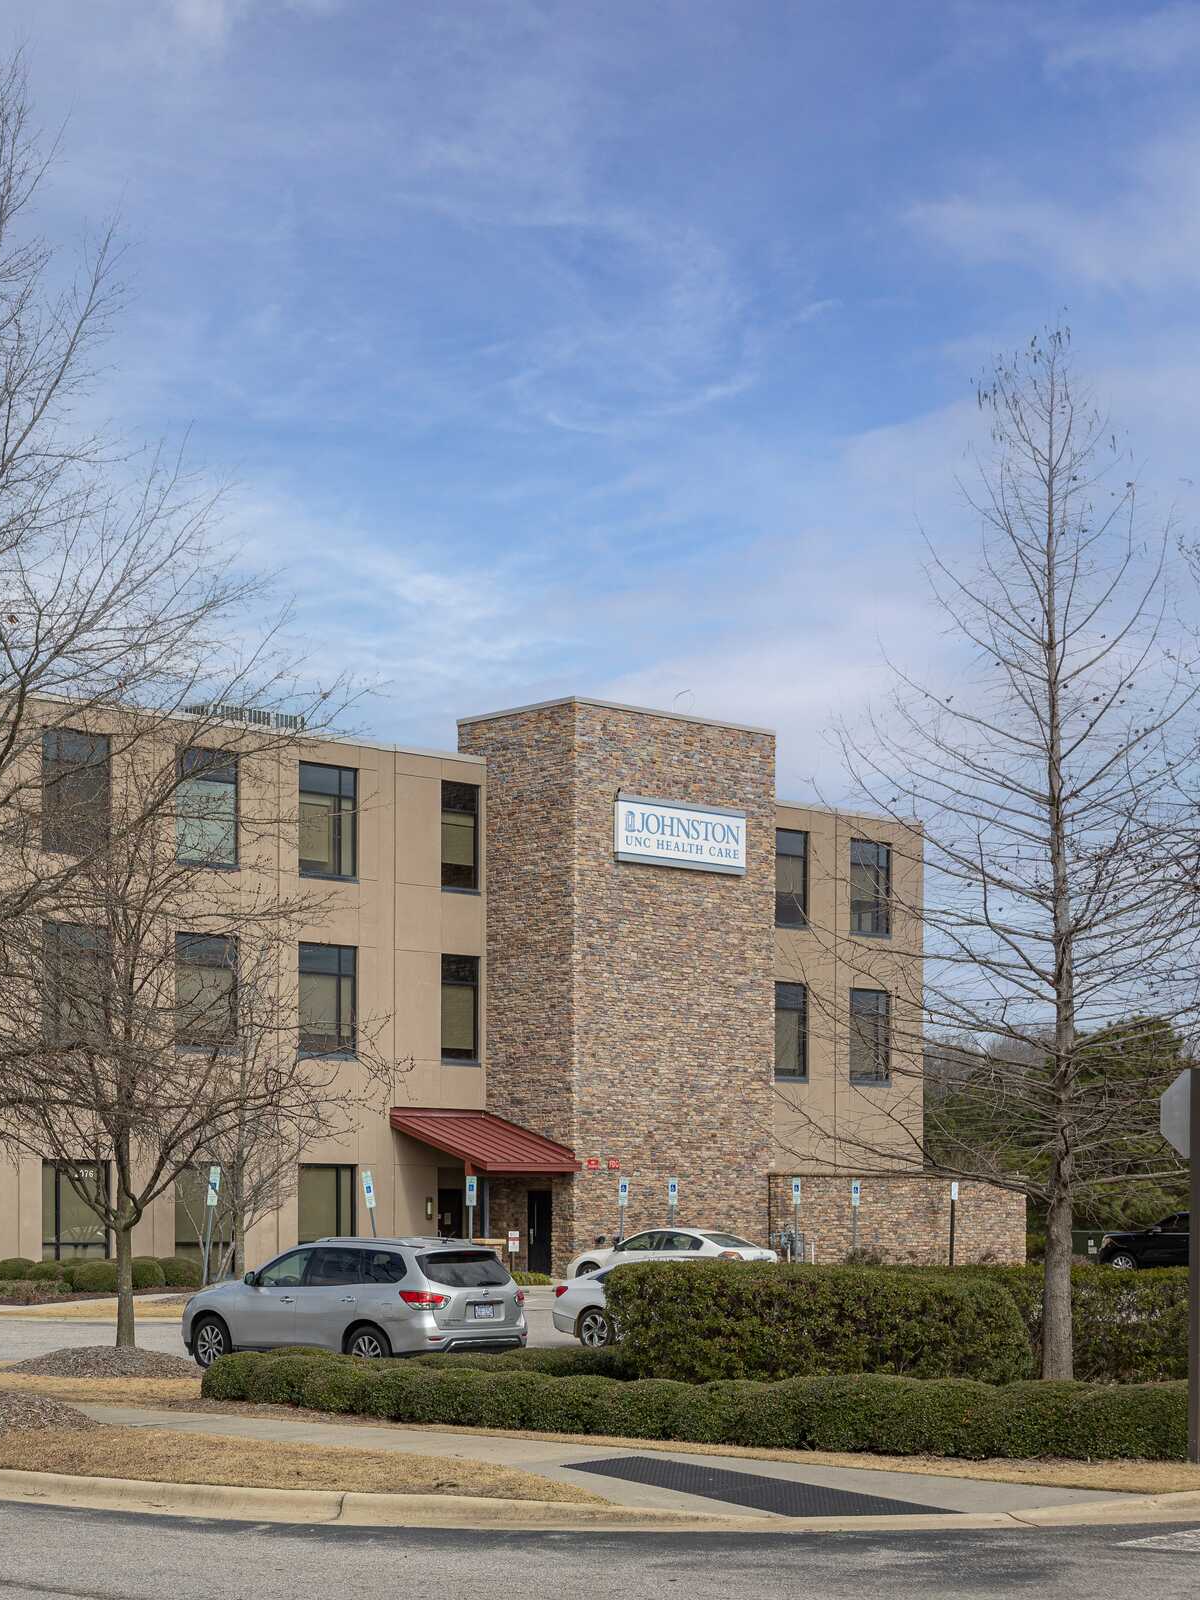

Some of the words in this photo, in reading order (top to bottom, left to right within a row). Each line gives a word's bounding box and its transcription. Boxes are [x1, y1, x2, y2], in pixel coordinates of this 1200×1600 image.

[637, 811, 740, 846] JOHNSTON
[625, 835, 650, 849] UNC
[656, 839, 703, 855] HEALTH
[709, 846, 740, 860] CARE
